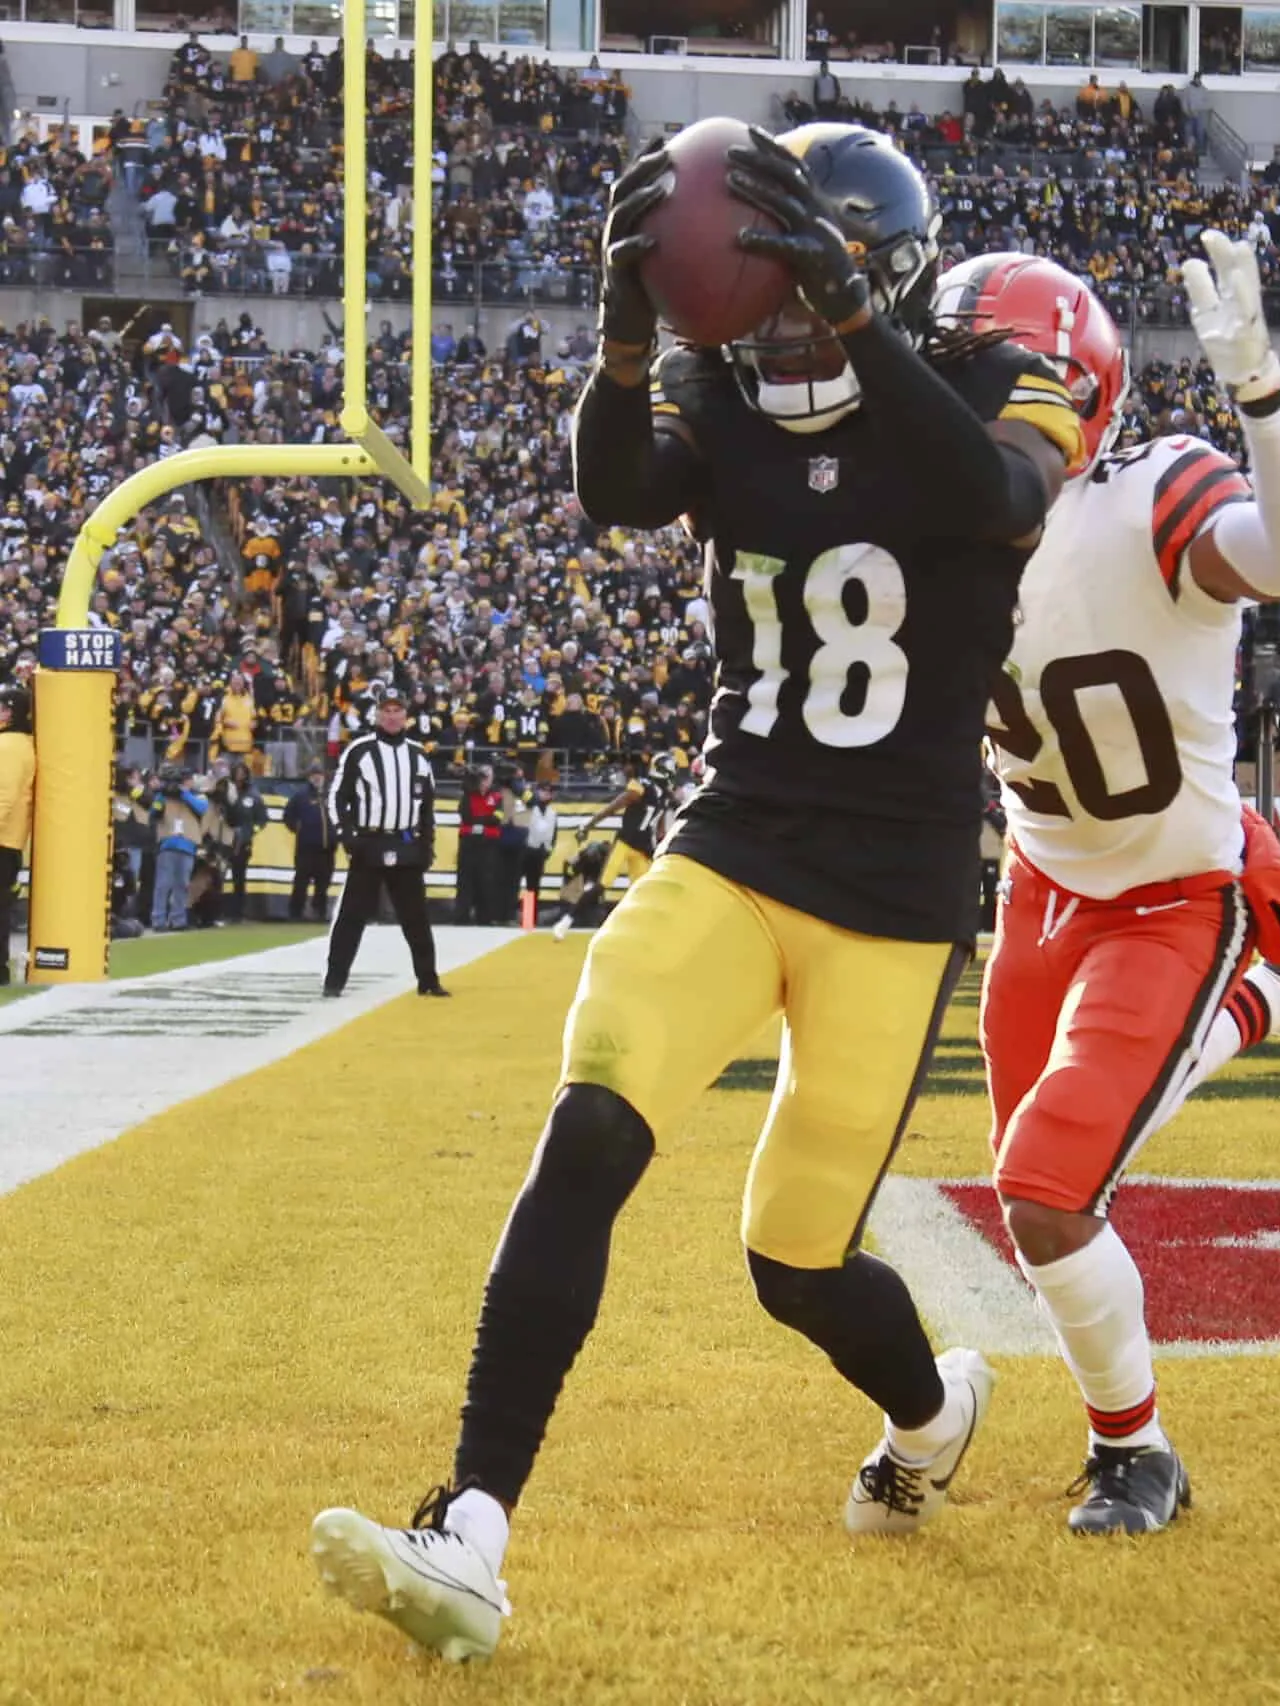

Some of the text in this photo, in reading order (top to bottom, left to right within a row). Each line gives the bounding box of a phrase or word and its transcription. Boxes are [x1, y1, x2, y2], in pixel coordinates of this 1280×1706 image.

[65, 634, 114, 649] STOP
[731, 542, 907, 747] 18
[66, 650, 113, 665] HATE
[520, 716, 536, 735] 14
